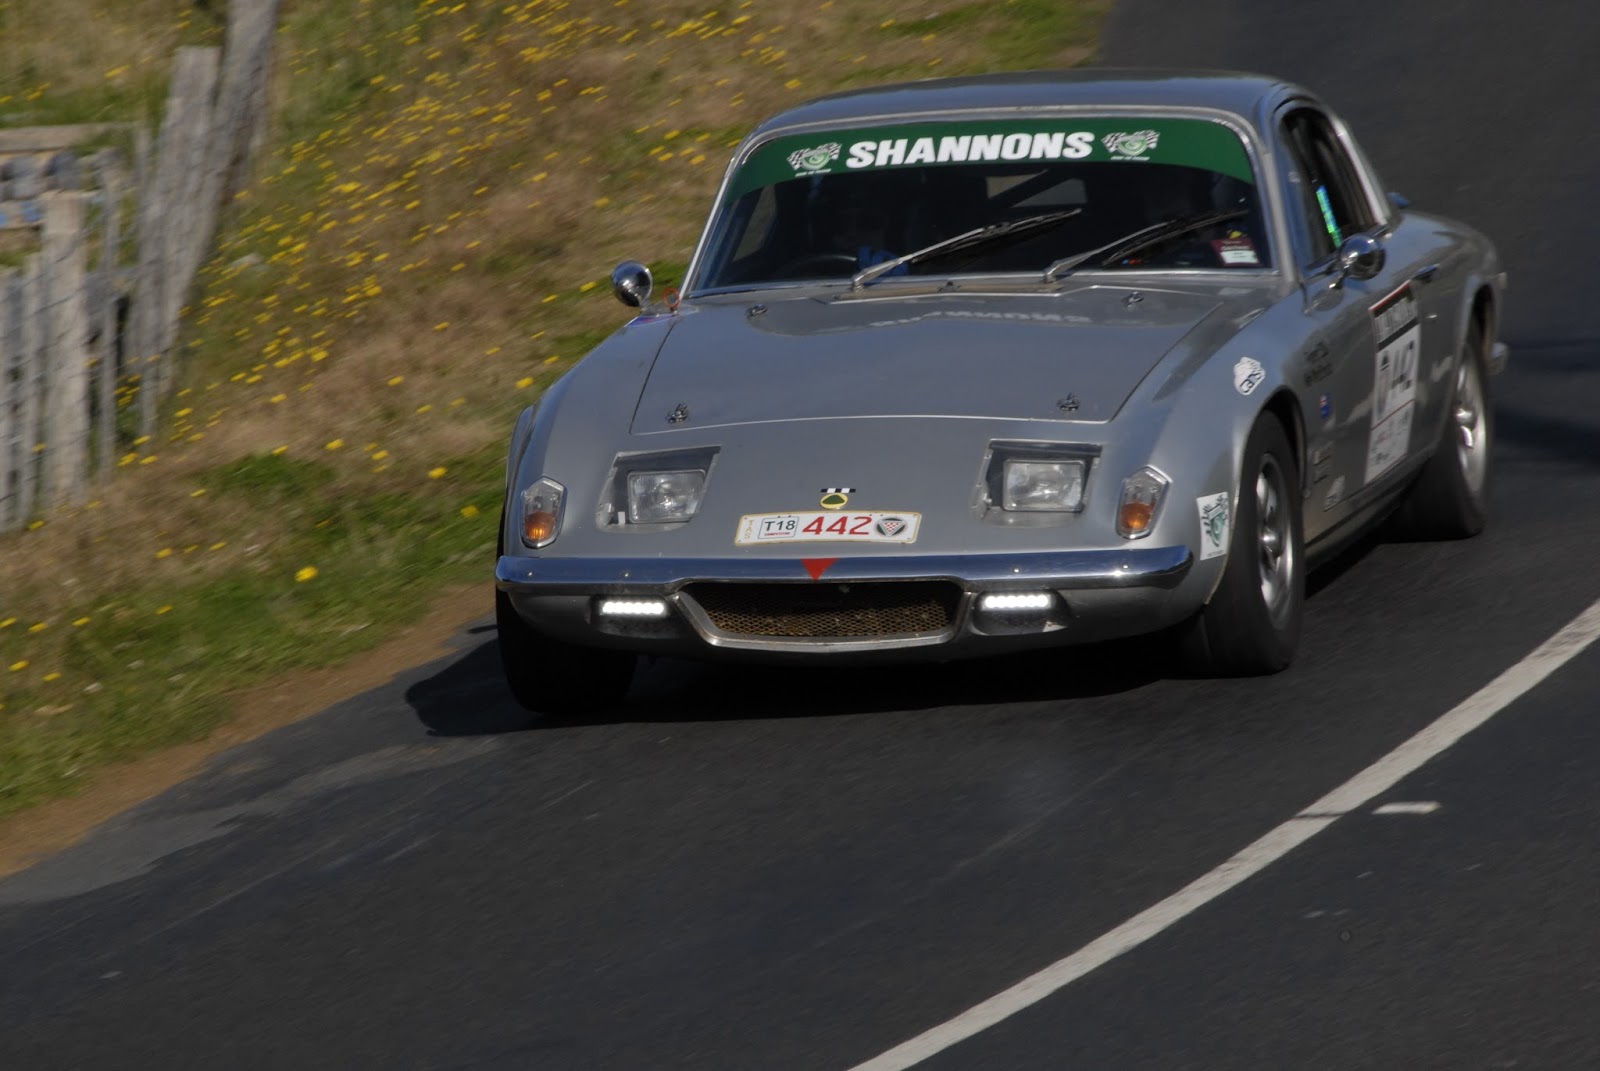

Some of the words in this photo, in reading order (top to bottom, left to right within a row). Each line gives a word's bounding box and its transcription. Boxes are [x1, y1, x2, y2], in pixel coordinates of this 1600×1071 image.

[845, 131, 1096, 169] SHANNONS
[764, 520, 796, 531] T18
[802, 516, 873, 535] 442
